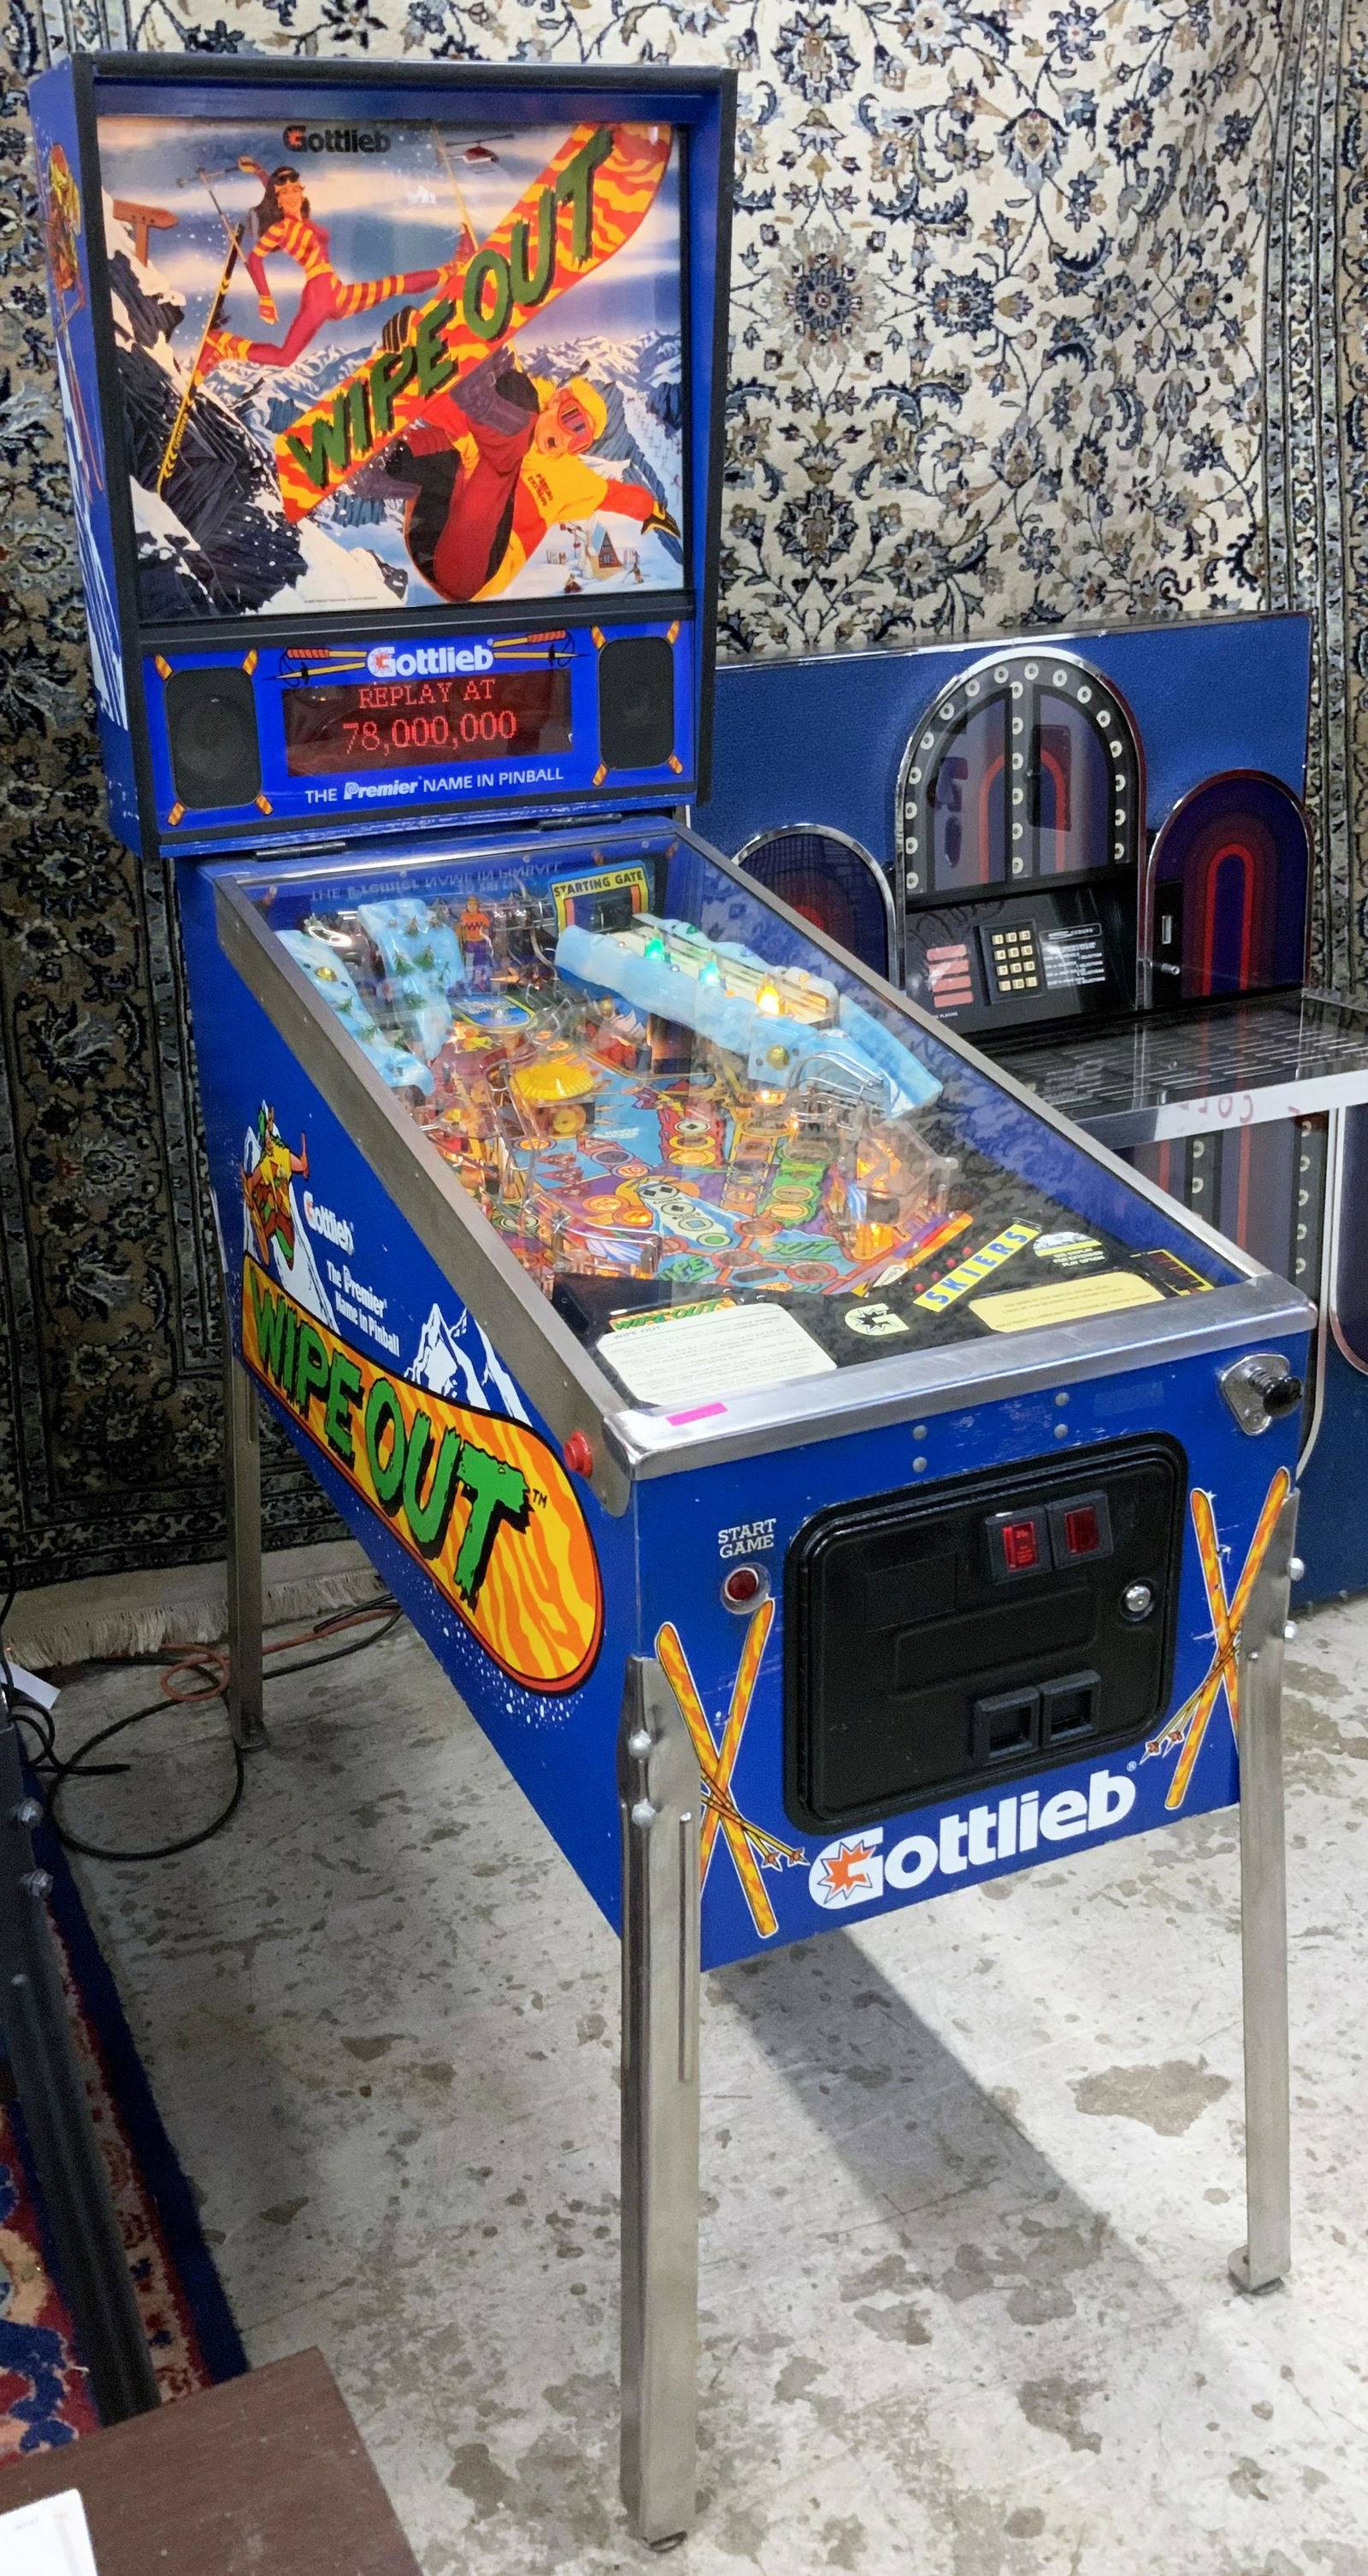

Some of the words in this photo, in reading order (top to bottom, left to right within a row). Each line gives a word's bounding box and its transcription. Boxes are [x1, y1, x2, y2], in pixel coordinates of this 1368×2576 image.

[283, 126, 391, 153] Gottlieb
[367, 644, 494, 678] Gottlieb
[357, 682, 453, 709] REPLAY
[463, 679, 496, 701] AT
[342, 709, 518, 756] 78,000,000
[304, 787, 339, 804] THE
[343, 779, 420, 801] Premier
[423, 775, 473, 793] NAME
[476, 773, 495, 787] IN
[498, 767, 565, 786] PINBALL
[552, 876, 611, 897] STARTING
[615, 870, 644, 885] GATE
[304, 1190, 355, 1257] Gottlieb
[925, 1231, 1028, 1304] SKIERS
[326, 1259, 343, 1288] The
[343, 1264, 386, 1318] Premier
[334, 1290, 359, 1324] Name
[359, 1309, 369, 1333] in
[368, 1314, 400, 1358] Pinball
[718, 1518, 776, 1544] START
[719, 1534, 775, 1559] GAME
[808, 1769, 1136, 1910] Gottlieb
